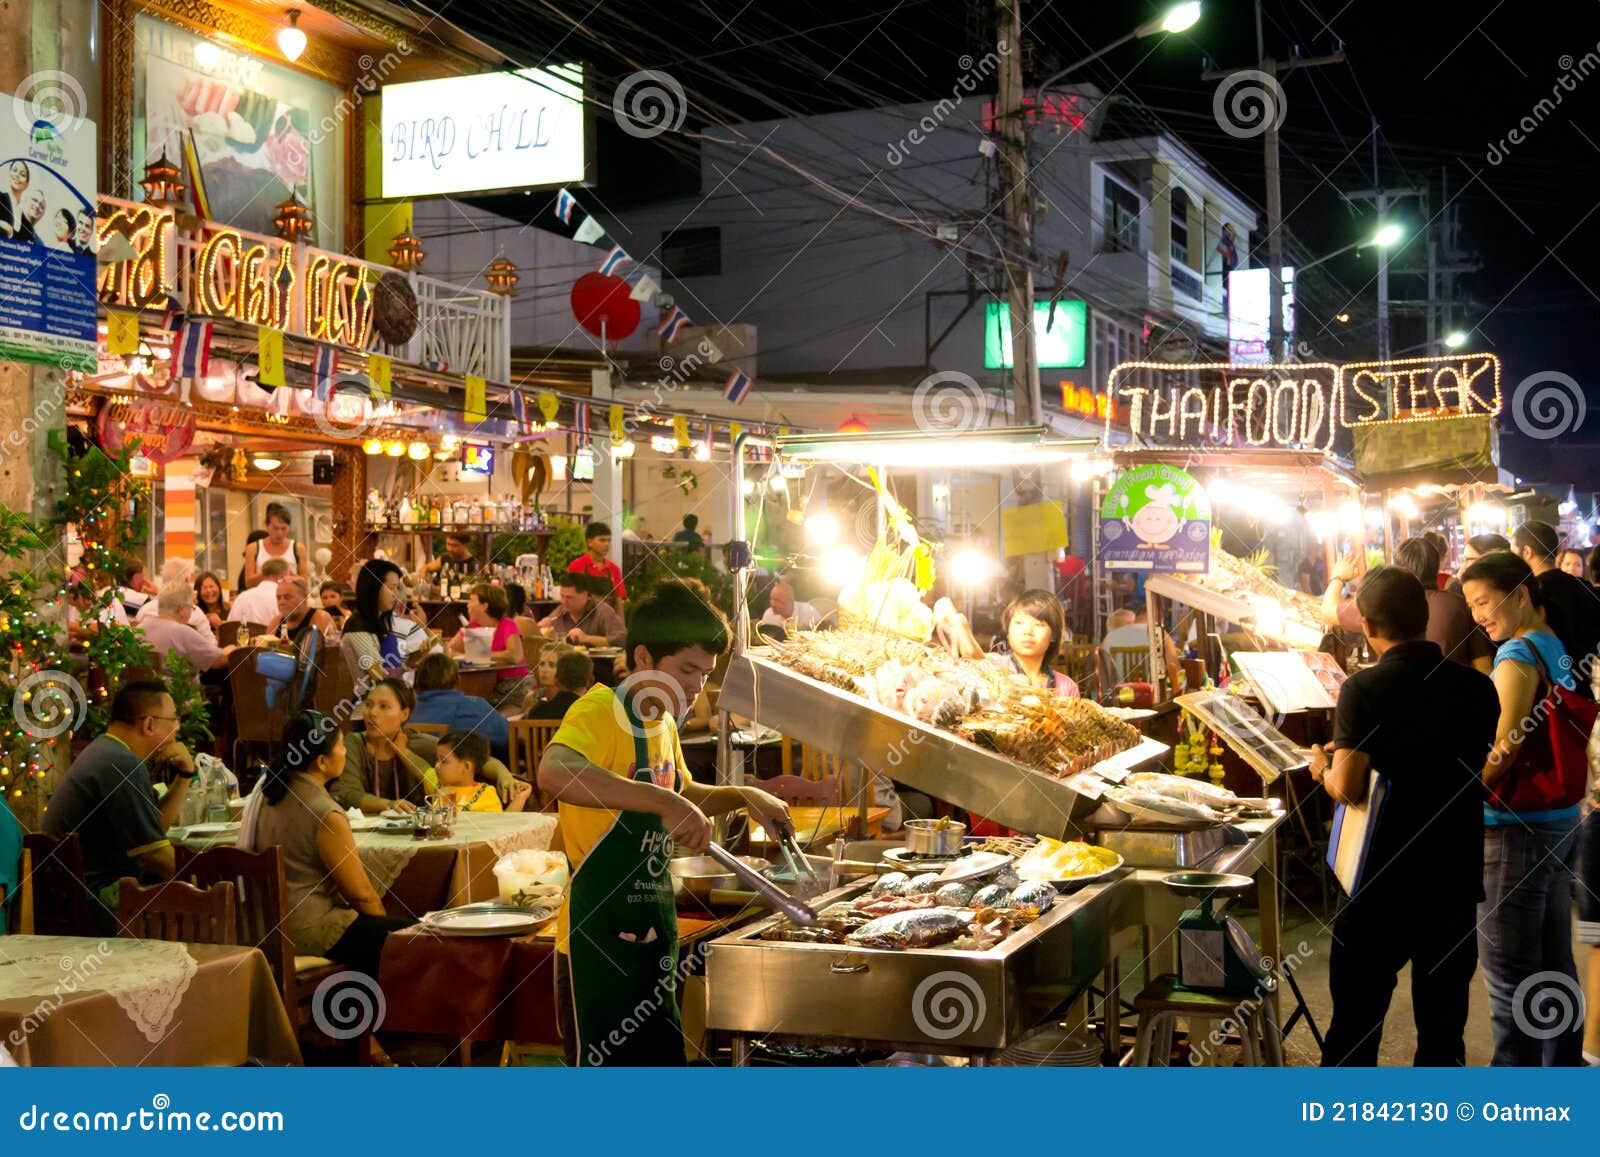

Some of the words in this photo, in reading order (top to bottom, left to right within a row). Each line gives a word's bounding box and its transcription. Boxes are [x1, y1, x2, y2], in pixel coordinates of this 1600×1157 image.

[390, 114, 456, 170] BIRD
[1118, 387, 1222, 441] THAI
[1226, 378, 1325, 446] FOOD
[1352, 360, 1498, 423] STEAK
[1125, 467, 1157, 486] Food
